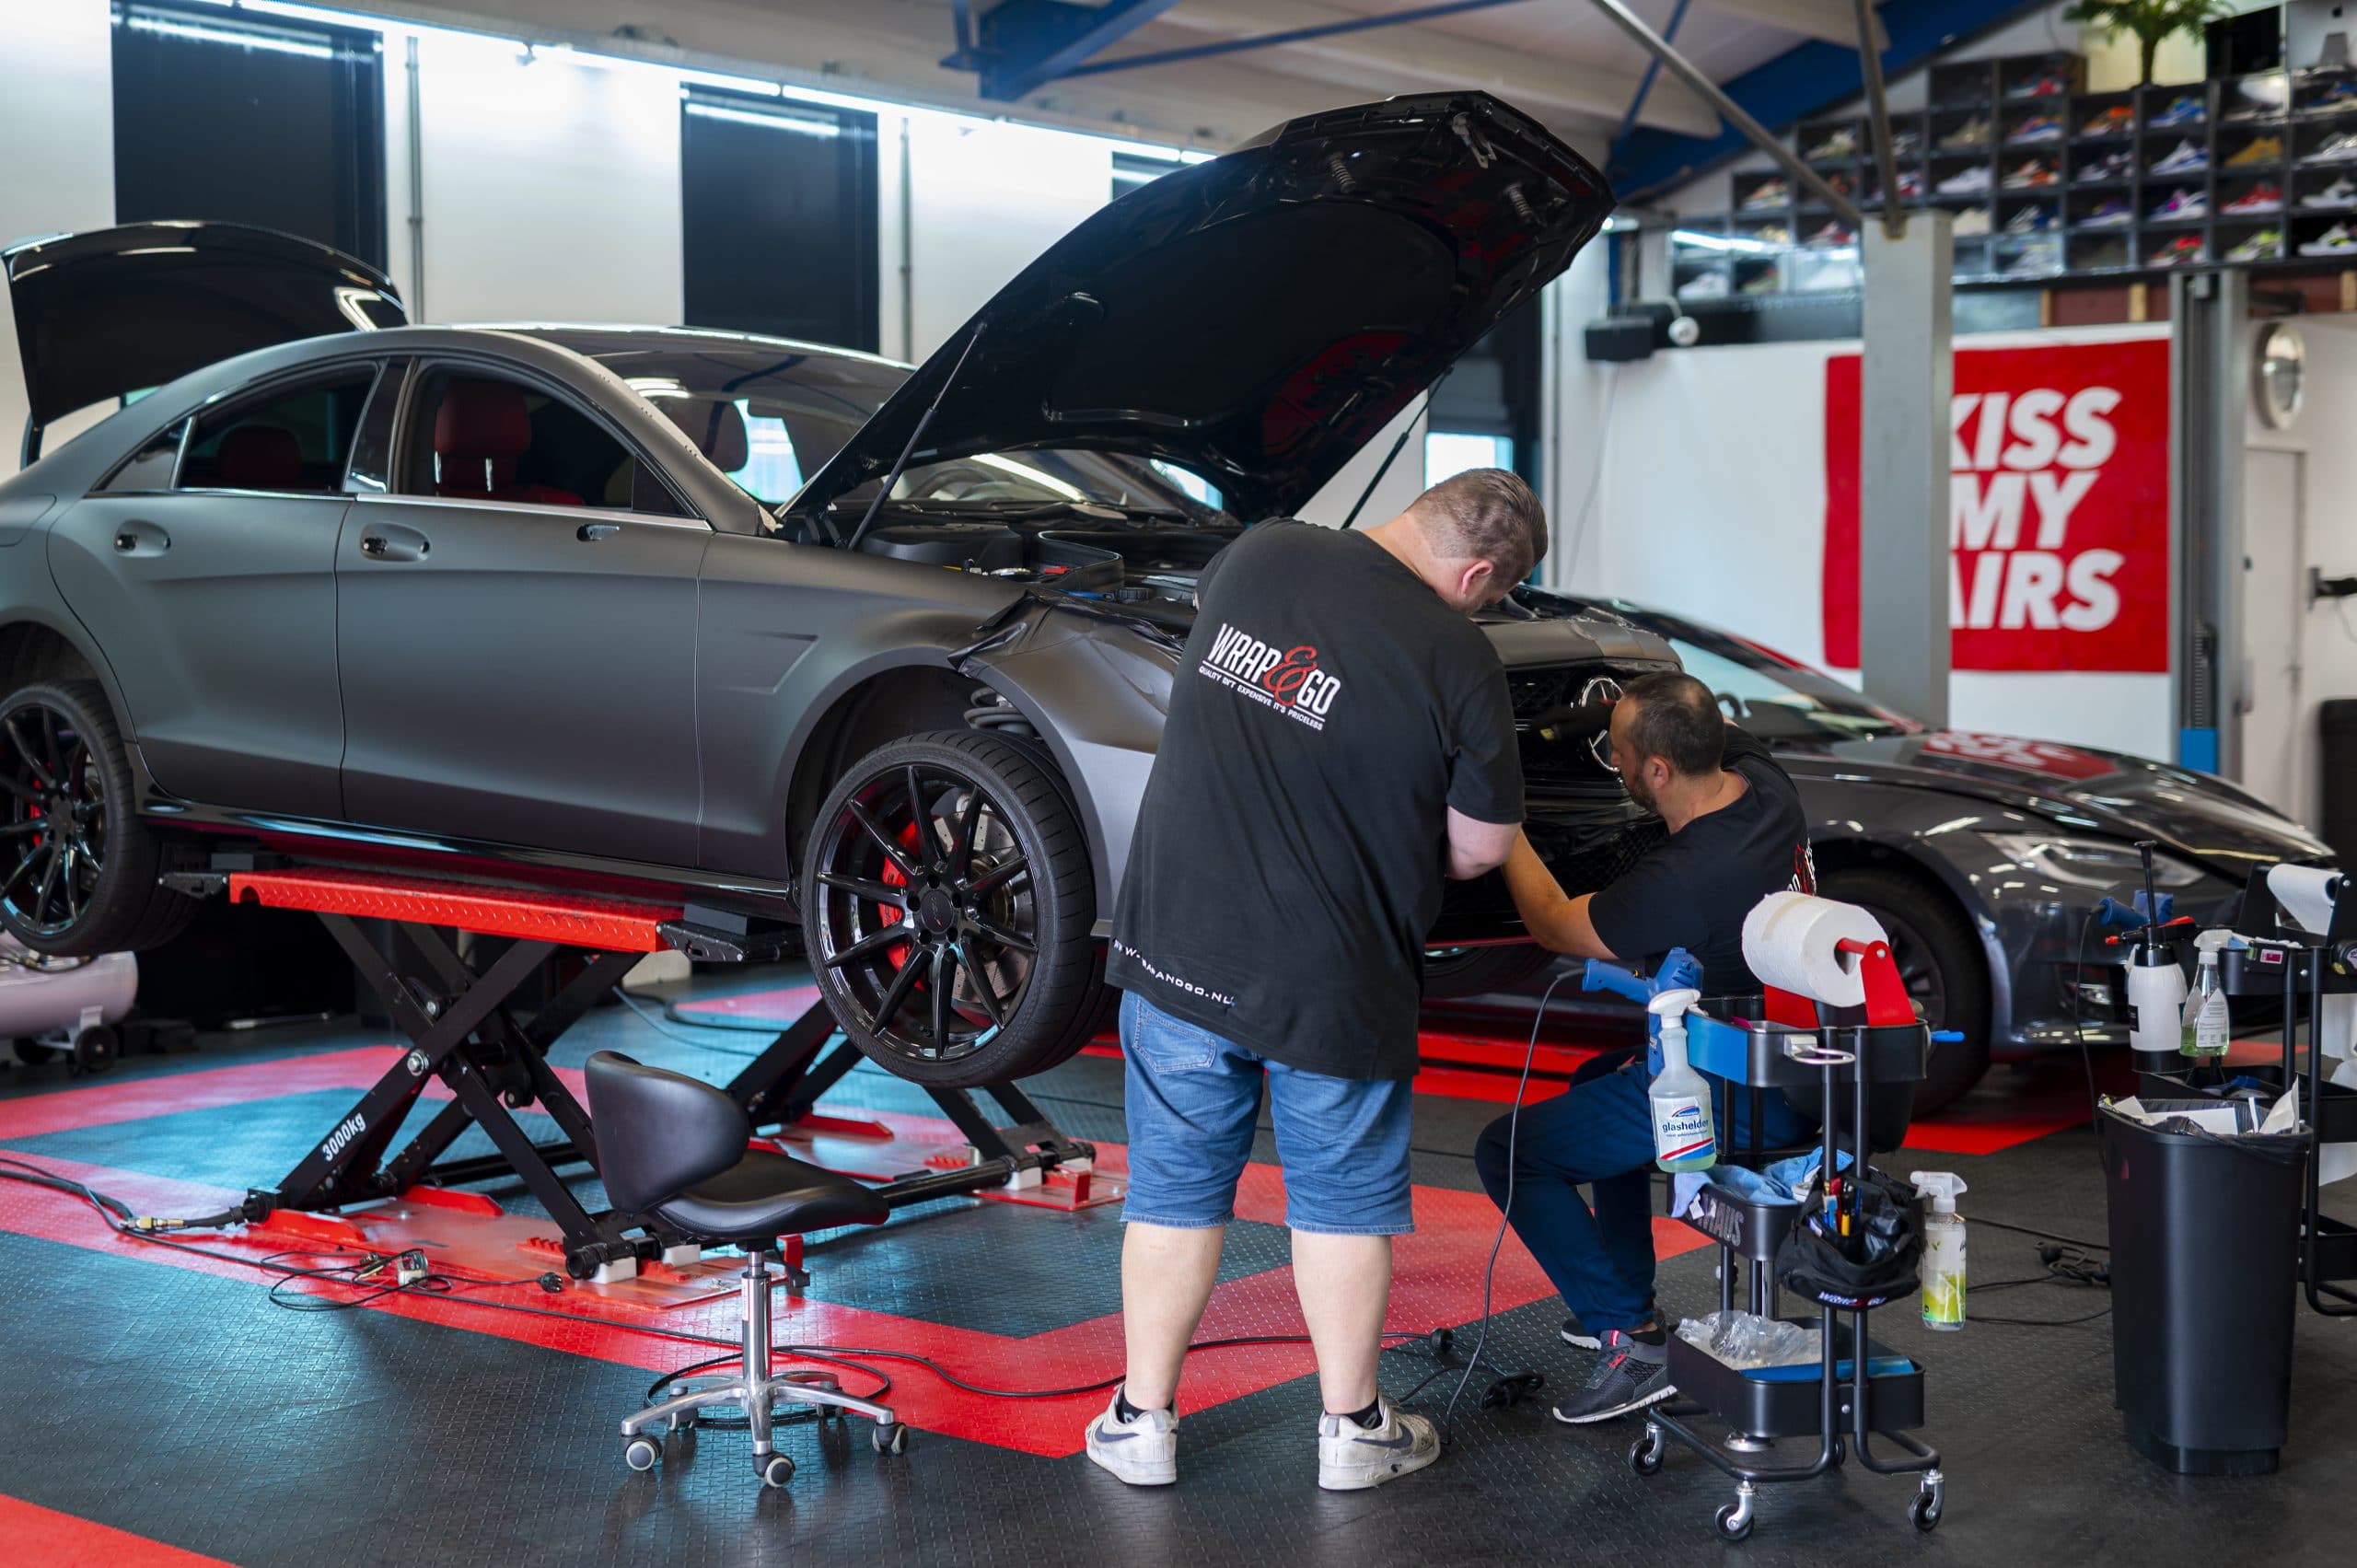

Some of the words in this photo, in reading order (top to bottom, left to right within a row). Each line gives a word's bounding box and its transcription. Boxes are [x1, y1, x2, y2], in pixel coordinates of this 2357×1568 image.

[1951, 387, 2122, 470] KISS
[1950, 470, 2100, 550] MY
[1199, 666, 1222, 682] QUALITY
[1237, 686, 1272, 707] EXPENSIVE
[1273, 702, 1286, 714] IT'S
[1287, 709, 1324, 731] PRICELESS
[322, 1112, 366, 1162] 3000kg
[1662, 1120, 1709, 1133] glashelder
